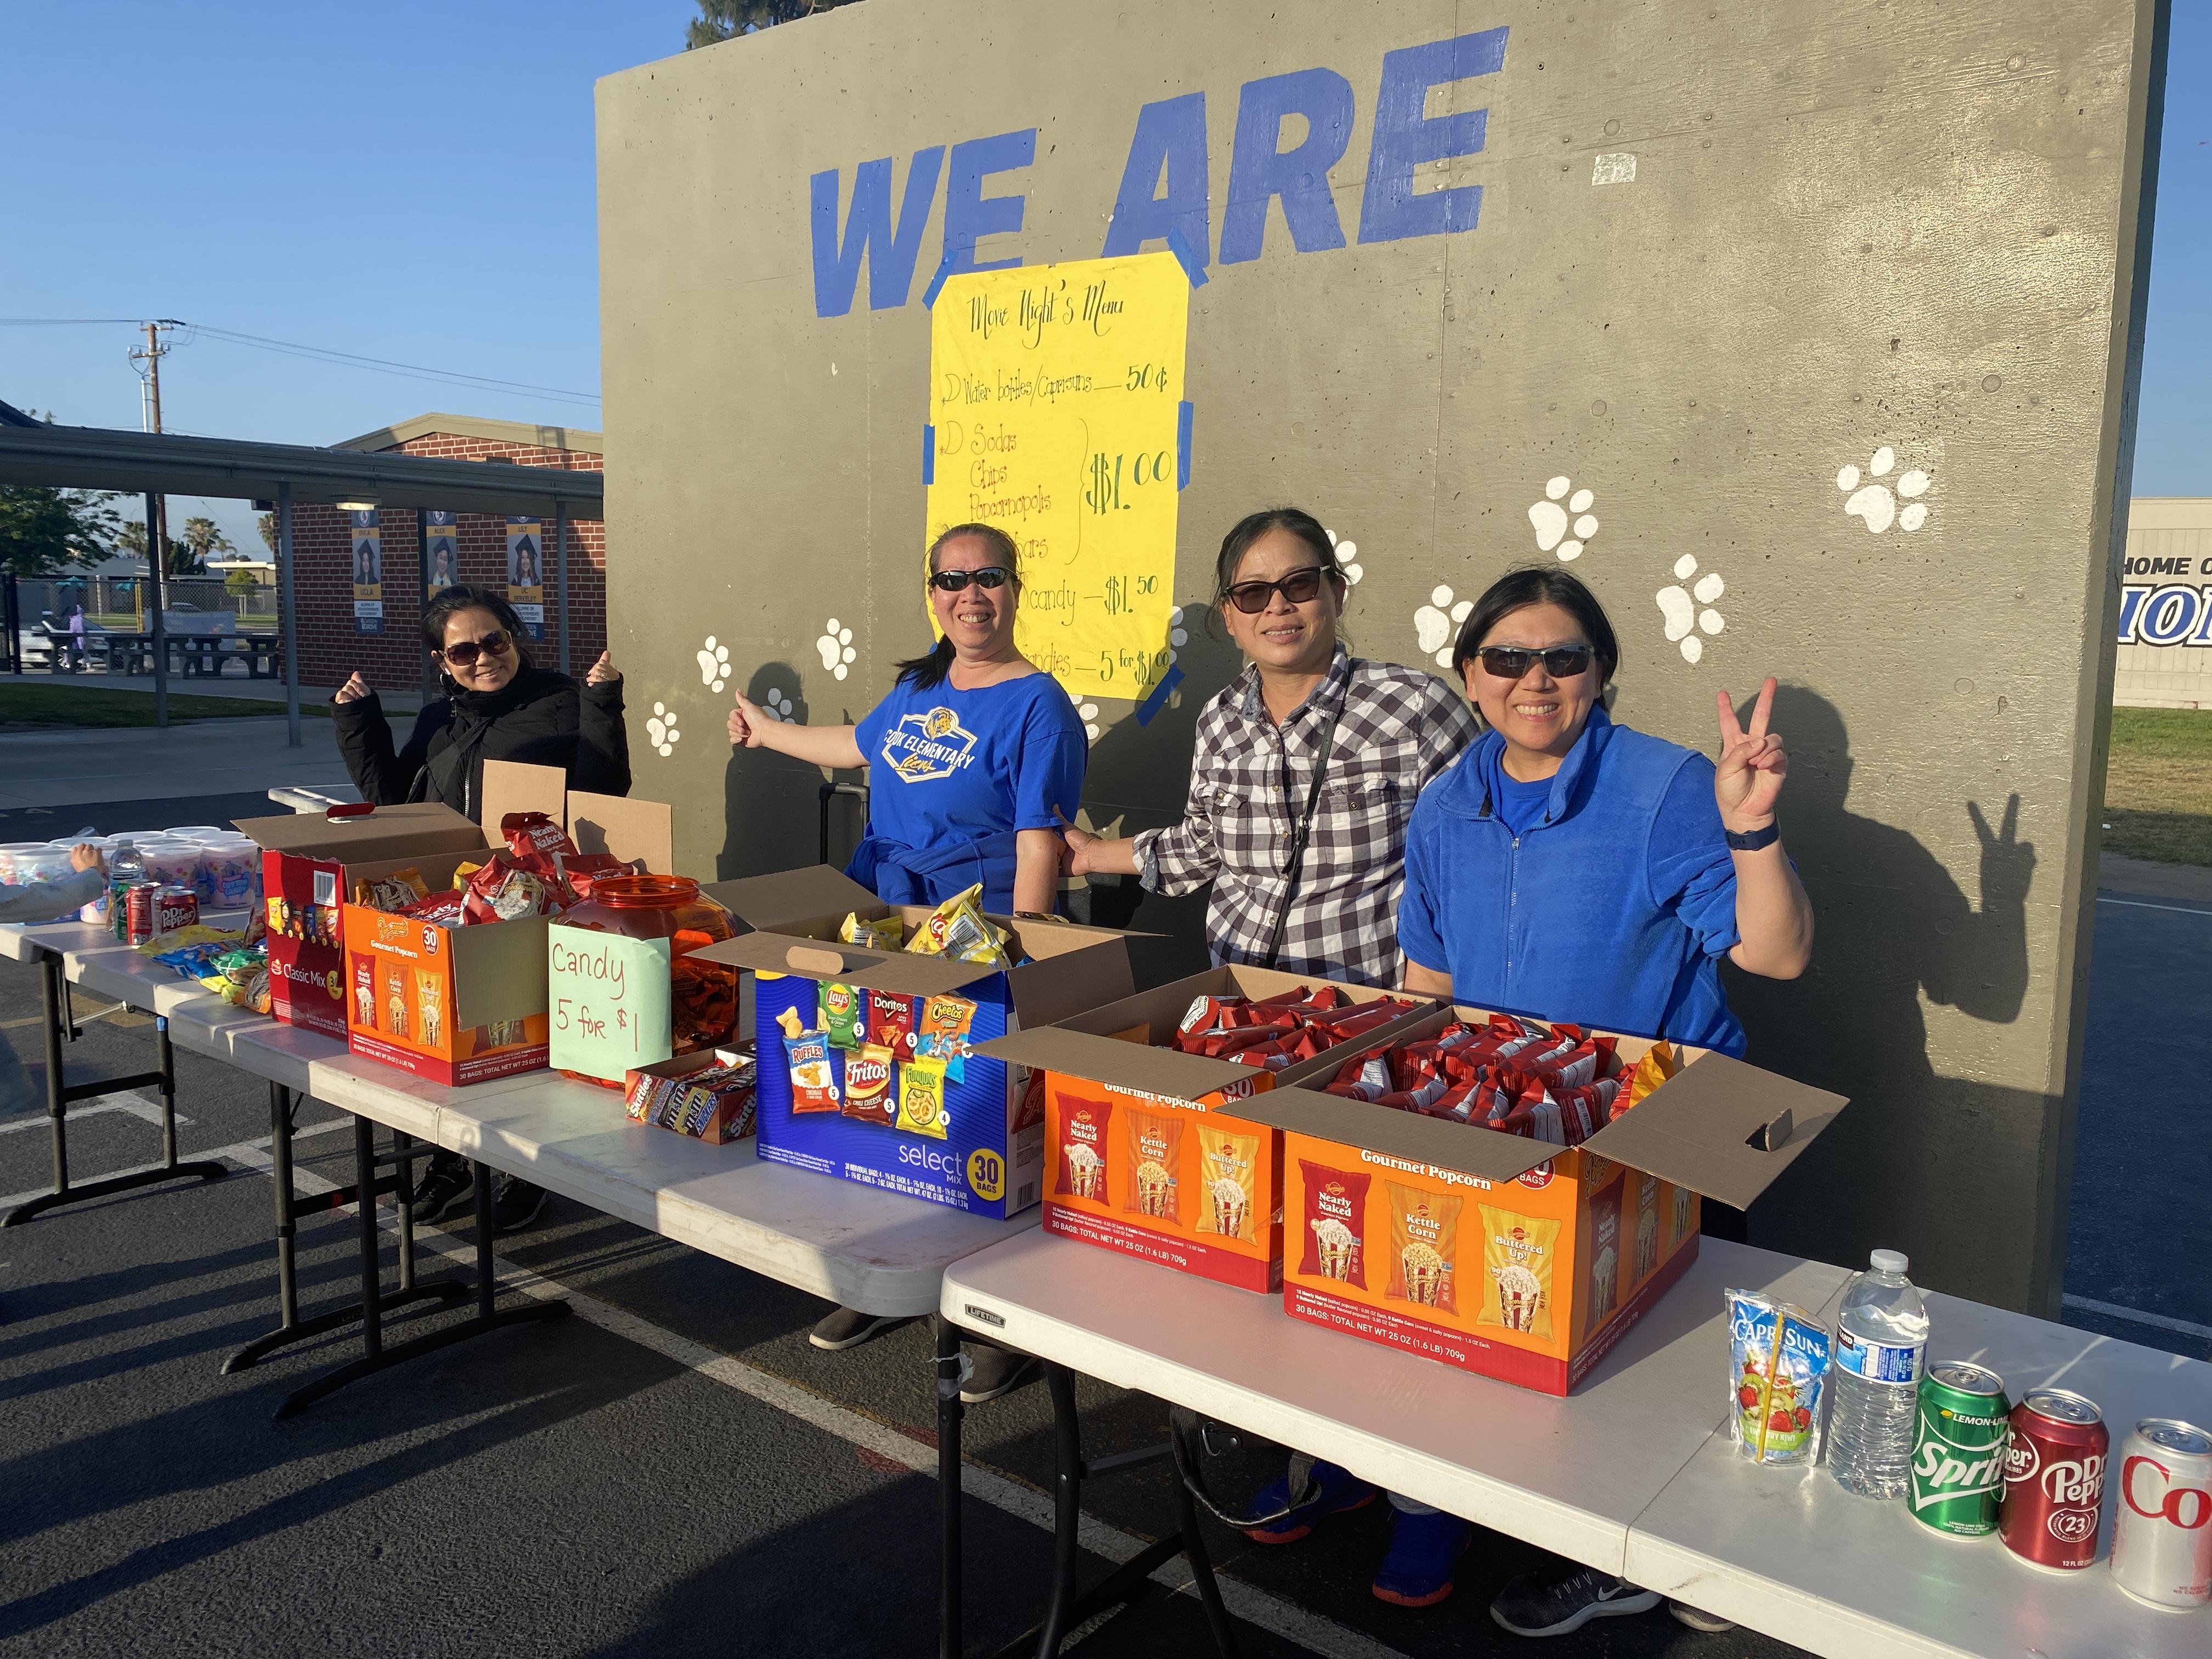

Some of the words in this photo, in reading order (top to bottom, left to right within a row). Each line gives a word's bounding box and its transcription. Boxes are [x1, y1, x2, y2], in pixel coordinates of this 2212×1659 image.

[810, 128, 1037, 318] WE
[1102, 26, 1510, 267] ARE
[967, 294, 1009, 340] Movie
[1083, 280, 1124, 336] Menu
[964, 373, 991, 404] Water
[971, 424, 1017, 455] Sodas
[970, 459, 1007, 493] Chips
[970, 484, 1051, 524] Popcornopolis
[1014, 531, 1048, 558] bars
[2125, 557, 2192, 575] HOME
[1030, 580, 1076, 625] candy
[1100, 651, 1114, 681] 5
[1119, 648, 1133, 667] for
[884, 729, 908, 747] COOK
[904, 735, 975, 769] ELEMENTARY
[528, 825, 556, 839] Nearly
[534, 831, 565, 850] Naked
[161, 910, 194, 928] Pepper
[170, 908, 185, 916] Dr
[424, 930, 437, 946] 30
[371, 939, 394, 953] Gourmet
[395, 946, 417, 958] Popcorn
[284, 964, 309, 984] Classic
[311, 970, 326, 988] Mix
[357, 970, 370, 979] Nearly
[358, 975, 370, 984] Naked
[552, 943, 625, 1000] Candy
[389, 978, 402, 987] Kettle
[390, 985, 401, 994] Corn
[421, 987, 438, 996] Buttered
[874, 997, 907, 1013] Doritos
[931, 1002, 964, 1022] Cheetos
[556, 998, 572, 1030] 5
[617, 1007, 637, 1052] $1
[857, 1025, 861, 1034] 5
[910, 1035, 913, 1045] 5
[792, 1046, 823, 1063] RUFFLES
[467, 1070, 483, 1078] BAGS:
[847, 1062, 887, 1086] Fritos
[906, 1066, 936, 1088] FUNYUNS
[630, 1075, 653, 1118] Skittles
[832, 1089, 836, 1097] 5
[864, 1094, 882, 1107] CHEESE
[887, 1101, 891, 1110] 5
[1158, 1095, 1206, 1113] Popcorn
[695, 1092, 718, 1135] SNICKERS
[941, 1113, 946, 1123] 4
[1070, 1120, 1097, 1133] Nearly
[1070, 1128, 1097, 1141] Naked
[1140, 1136, 1167, 1149] Kettle
[899, 1144, 962, 1176] select
[1142, 1146, 1164, 1158] Corn
[1210, 1152, 1247, 1169] Buttered
[975, 1155, 998, 1184] 30
[1220, 1163, 1235, 1173] Up!
[1361, 1149, 1426, 1175] Gourmet
[1427, 1165, 1492, 1191] Popcorn
[946, 1174, 962, 1185] MIX
[977, 1182, 997, 1194] BAGS
[1519, 1173, 1544, 1186] BAGS
[896, 1183, 907, 1193] TOTAL
[963, 1201, 968, 1210] kg
[1318, 1192, 1352, 1209] Nearly
[1642, 1190, 1654, 1206] Corn
[1318, 1200, 1352, 1217] Naked
[1406, 1214, 1441, 1230] Kettle
[1599, 1214, 1616, 1234] Nearly
[1408, 1224, 1436, 1239] Corn
[1598, 1223, 1615, 1246] Naked
[1060, 1223, 1078, 1234] BAGS:
[1080, 1228, 1099, 1240] TOTAL
[1101, 1234, 1113, 1244] NET
[1114, 1238, 1125, 1247] WT
[1135, 1244, 1143, 1252] OZ
[1146, 1246, 1157, 1256] (1.6
[1158, 1251, 1169, 1261] LB)
[1171, 1254, 1186, 1266] 709g
[1495, 1235, 1543, 1255] Buttered
[1509, 1248, 1527, 1261] Up!
[970, 1307, 1001, 1324] LIFETIME
[1296, 1304, 1305, 1313] 30
[1307, 1307, 1329, 1321] BAGS:
[1330, 1314, 1355, 1328] TOTAL
[1357, 1322, 1373, 1333] NET
[1374, 1327, 1387, 1337] WT
[1389, 1331, 1398, 1341] 25
[1400, 1335, 1412, 1345] OZ
[1413, 1338, 1428, 1349] (1.6
[1430, 1344, 1443, 1355] LB)
[1444, 1348, 1465, 1362] 709g
[1735, 1319, 1777, 1341] CAPR
[1785, 1328, 1821, 1358] SUN
[1913, 1441, 2006, 1488] Sprit
[2083, 1454, 2108, 1482] Dr
[2041, 1461, 2104, 1506] Pepp
[2065, 1516, 2085, 1533] 23
